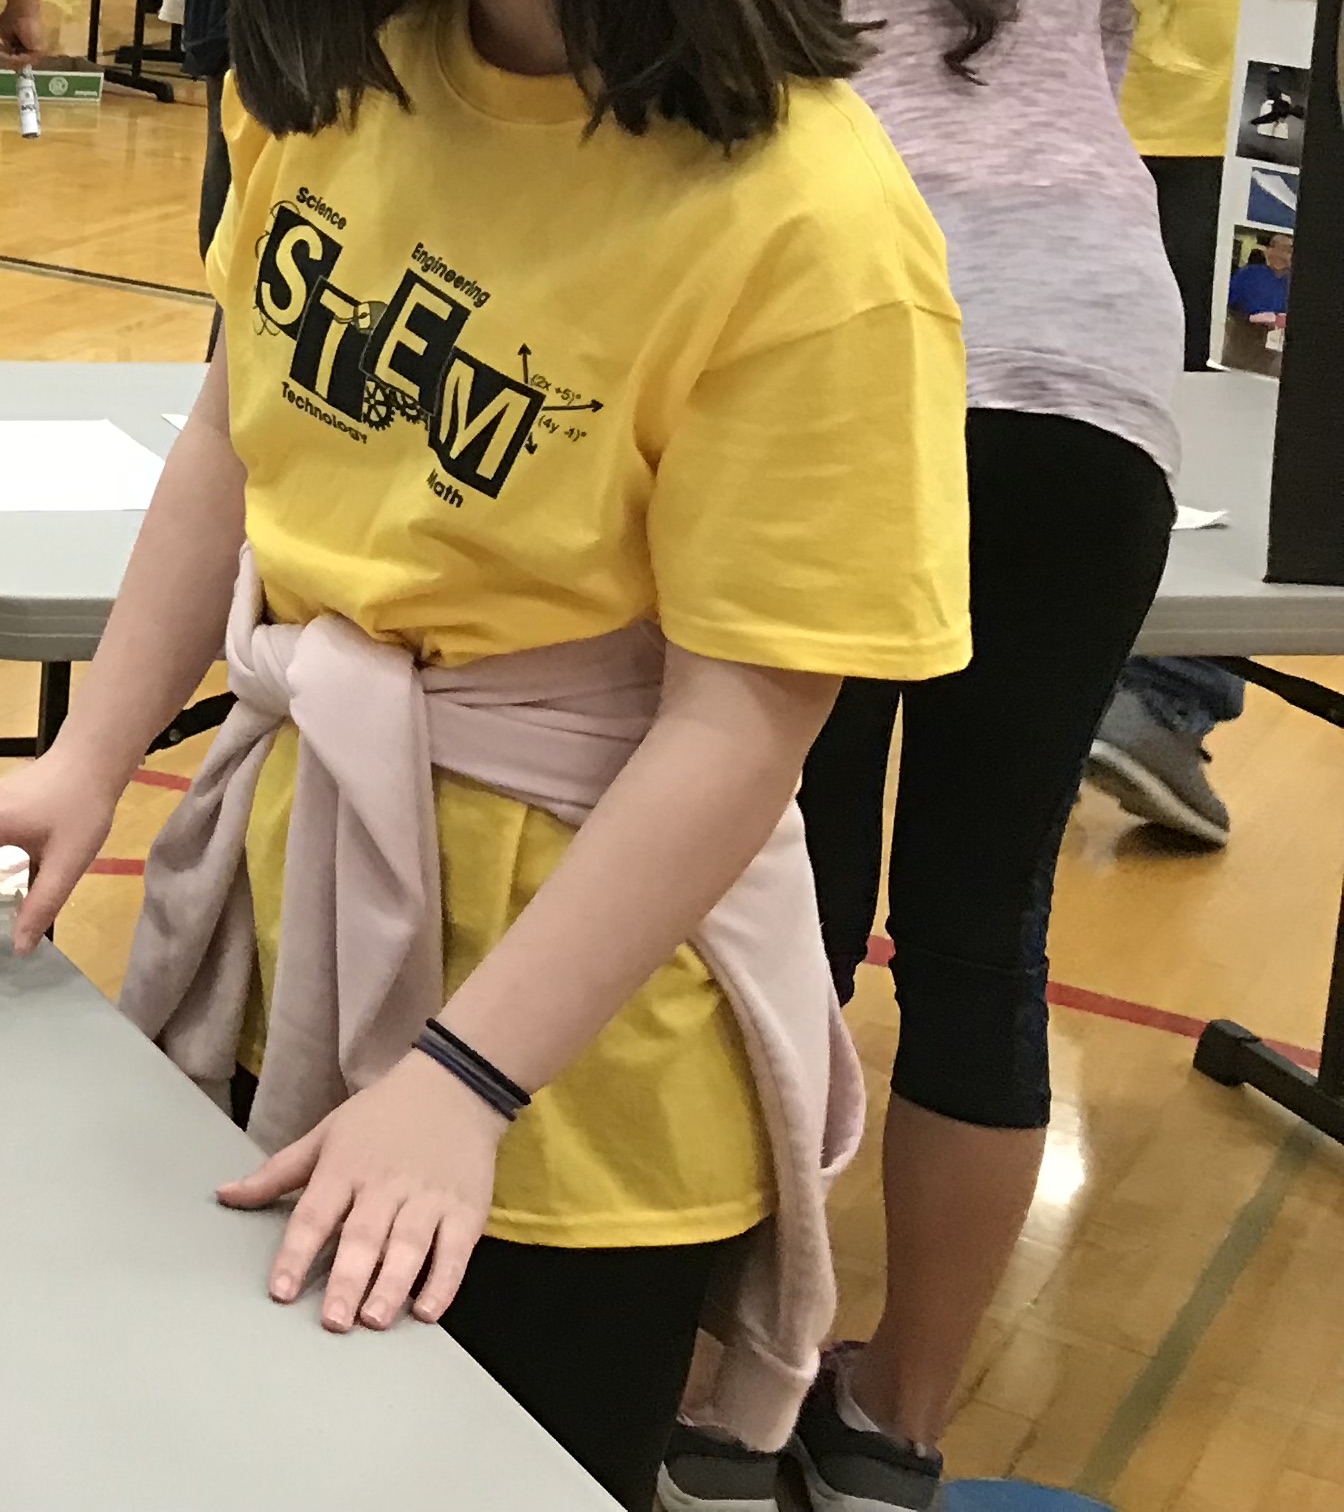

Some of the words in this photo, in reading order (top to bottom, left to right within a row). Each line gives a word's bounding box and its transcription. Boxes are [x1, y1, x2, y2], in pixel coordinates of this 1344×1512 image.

[295, 186, 348, 231] Science
[410, 241, 492, 309] Engineering
[261, 223, 532, 483] STEM
[280, 381, 368, 445] Technology
[425, 467, 465, 509] Math
